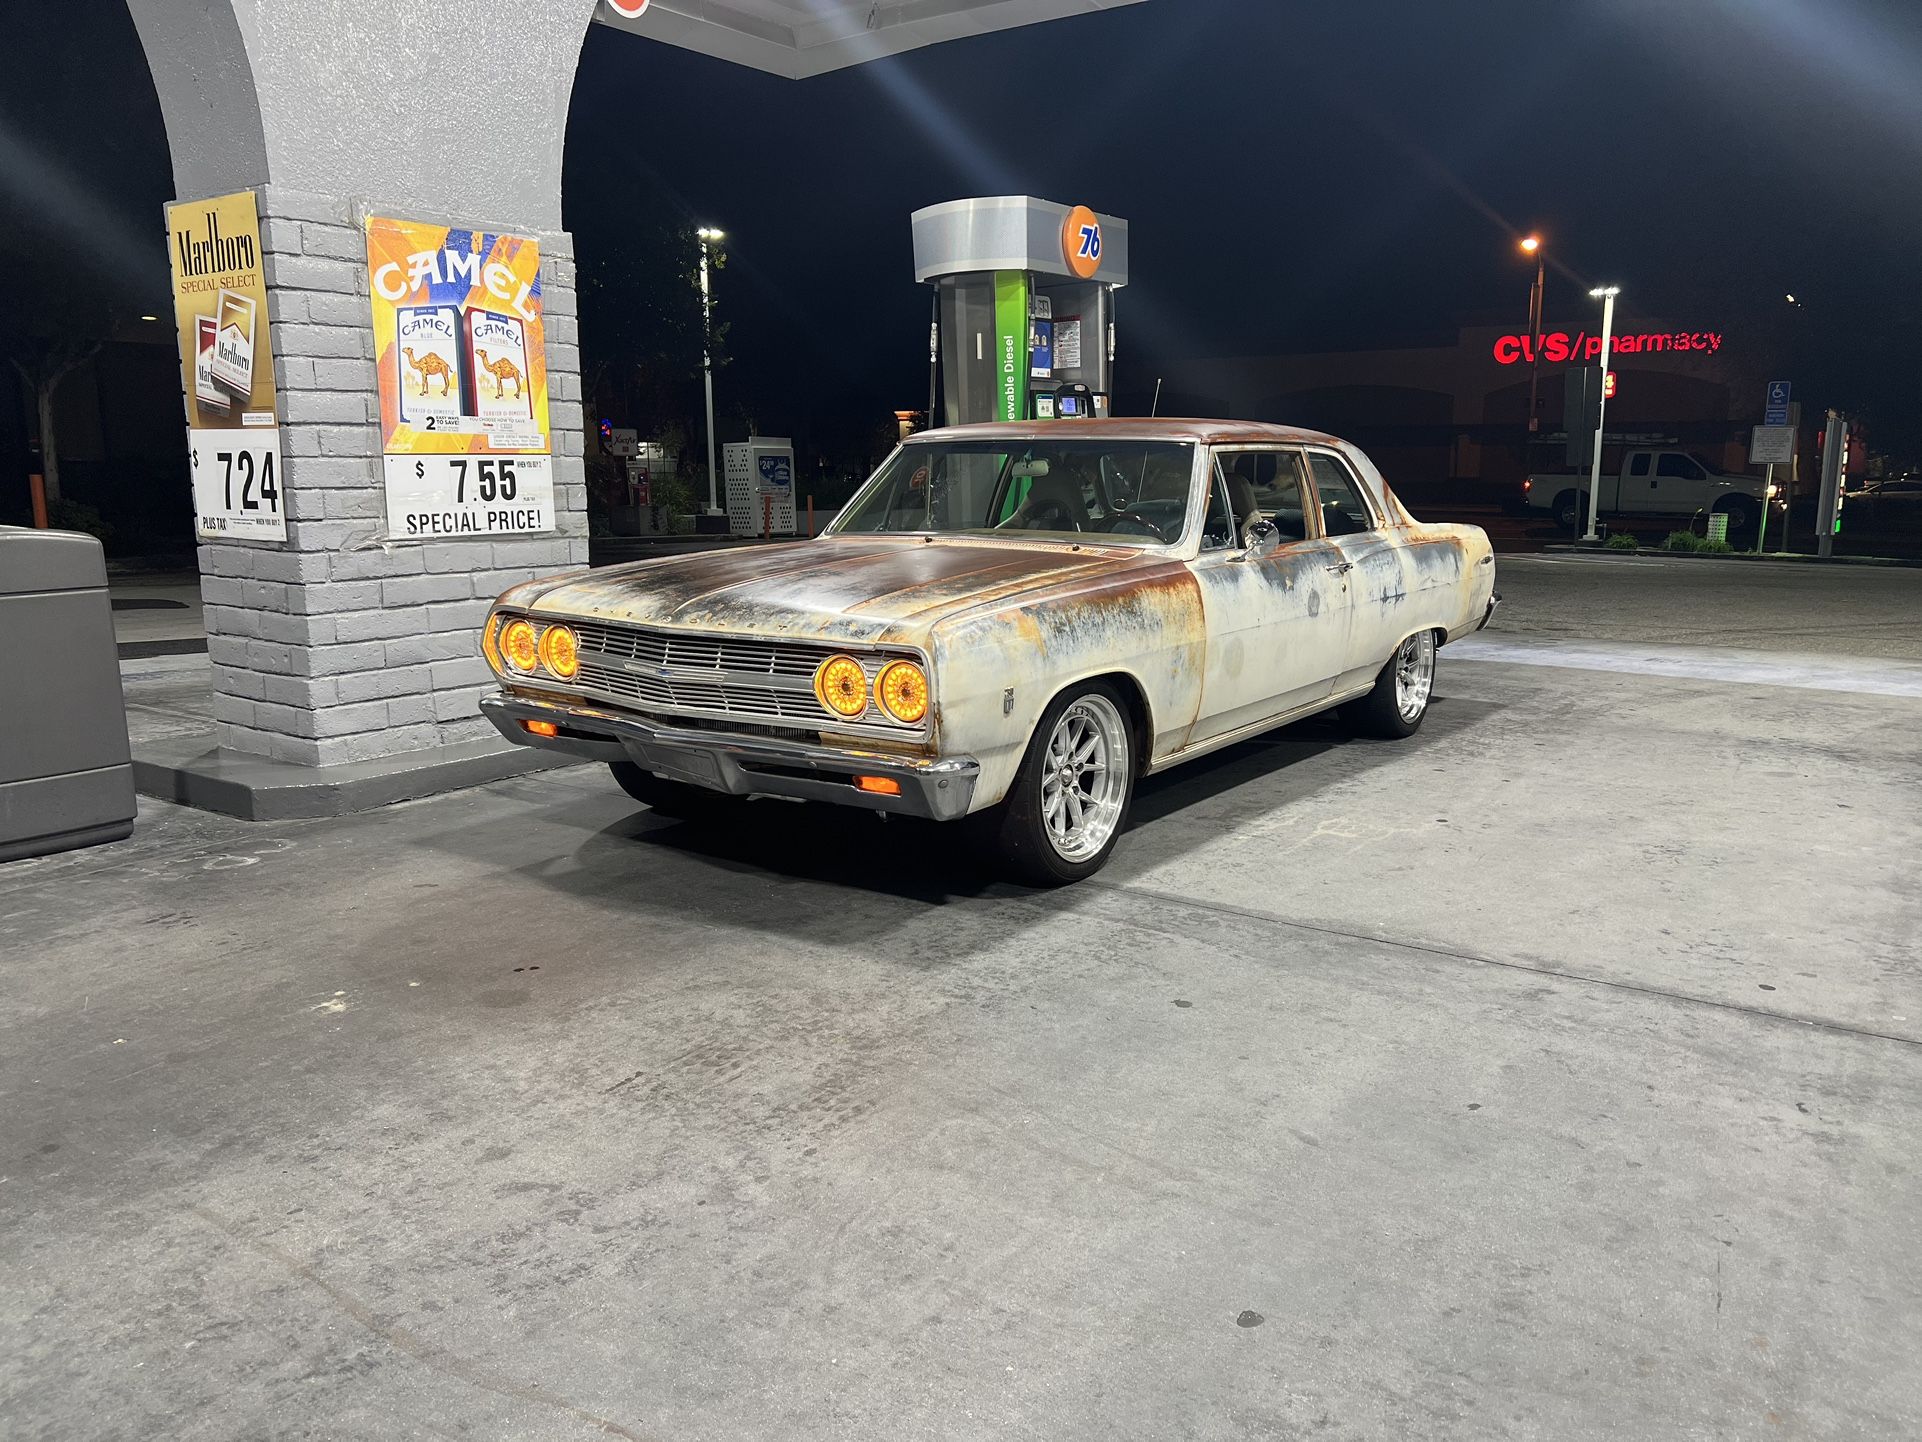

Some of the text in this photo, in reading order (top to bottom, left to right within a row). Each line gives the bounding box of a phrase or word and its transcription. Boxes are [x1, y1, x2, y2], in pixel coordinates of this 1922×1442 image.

[177, 211, 255, 278] Marlboro
[1077, 223, 1101, 261] 76
[180, 273, 257, 295] SPECIAL SELECT
[373, 249, 537, 323] CAMEL
[401, 318, 453, 338] CAMEL
[474, 324, 522, 347] CAMEL
[218, 340, 250, 371] Marlboro
[1003, 335, 1015, 422] ewable Diesel
[426, 416, 436, 430] 2
[192, 448, 199, 470] $
[415, 459, 517, 504] $ 7.55
[203, 516, 217, 530] PLUS
[217, 517, 227, 531] TAX
[405, 509, 542, 535] SPECIAL PRICE!
